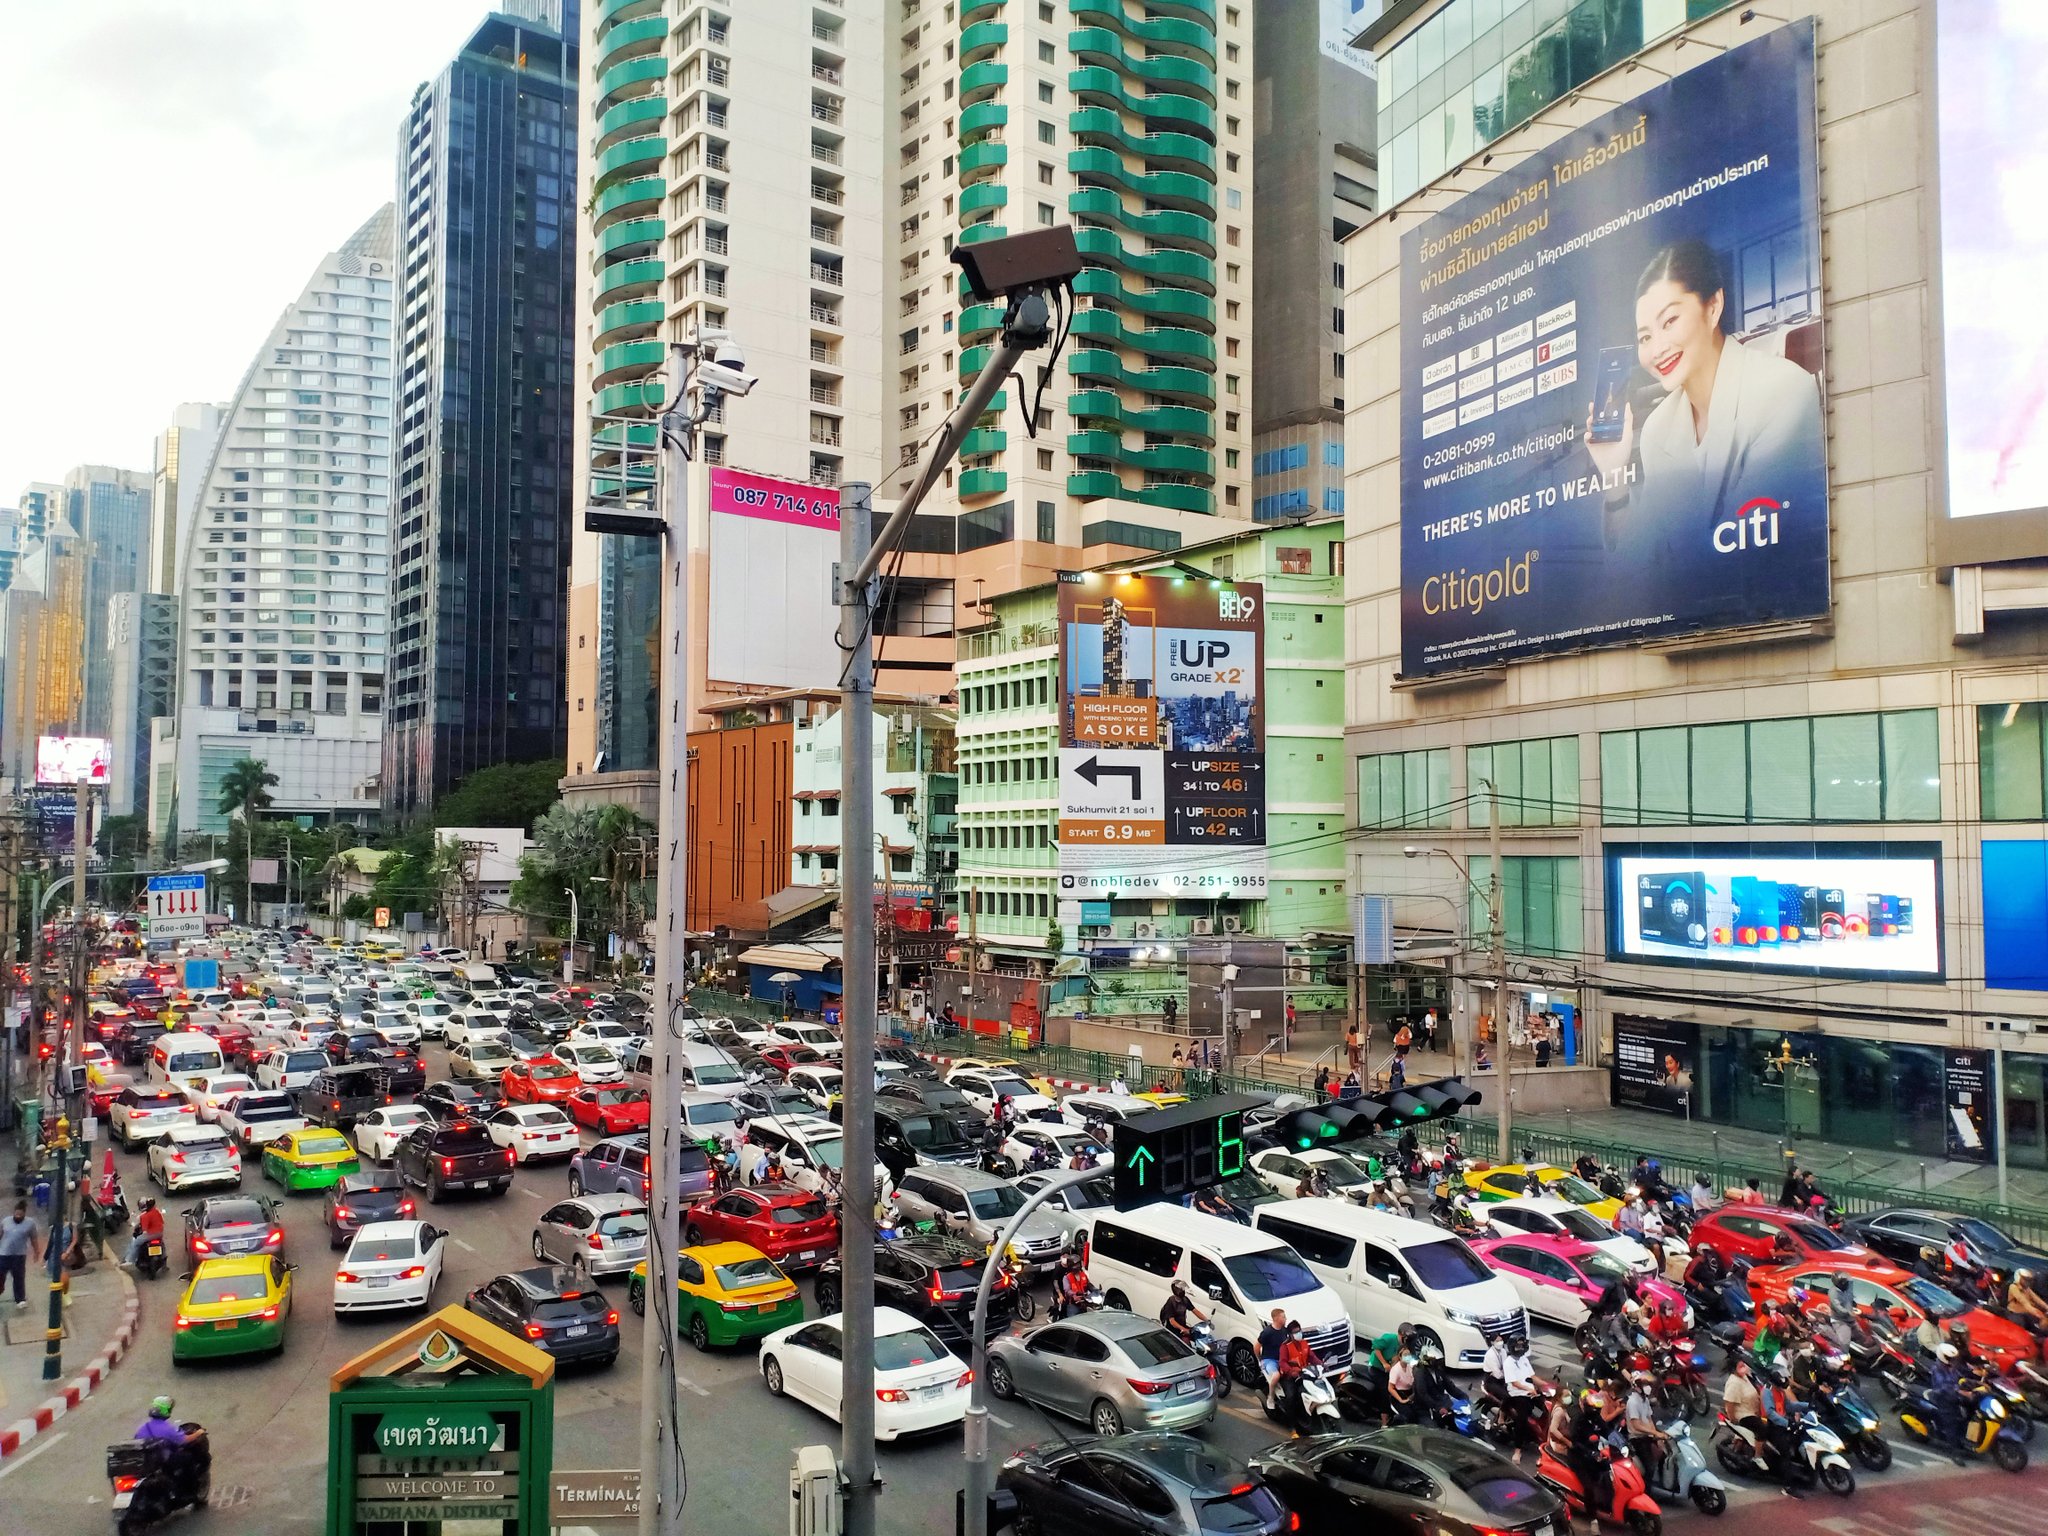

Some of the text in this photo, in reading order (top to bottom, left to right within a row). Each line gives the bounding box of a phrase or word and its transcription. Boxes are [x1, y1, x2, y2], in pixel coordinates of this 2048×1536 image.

[1420, 115, 1647, 264] ซื้อขายกองทุนง่ายๆ ได้แล้ววันนี้
[1420, 210, 1549, 294] ผ่านซิตี้โมบายล์แอป
[1496, 295, 1509, 314] 12
[1513, 286, 1536, 305] บลจ.
[1538, 310, 1573, 330] BlackRock
[1551, 338, 1575, 354] Fidelity
[1553, 365, 1575, 384] UBS
[1499, 385, 1532, 405] Schroders
[1423, 432, 1496, 469] 0-2081-0999
[1423, 425, 1574, 490] www.citibank.co.th/citigold
[734, 487, 768, 506] 087
[773, 493, 807, 514] 714
[1422, 462, 1637, 543] THERE'S MORE TO WEALTH
[1554, 627, 1583, 640] registered
[1583, 624, 1605, 635] service
[1605, 620, 1622, 631] mark
[1622, 619, 1630, 628] of
[1630, 615, 1662, 628] Citigroup
[1662, 613, 1676, 622] Inc.
[1180, 639, 1231, 669] UP
[1170, 672, 1212, 683] GRADE
[1083, 703, 1148, 714] HIGH FLOOR
[1084, 724, 1148, 737] ASOKE
[1191, 761, 1240, 773] UPSIZE
[1183, 781, 1197, 791] 34
[1204, 782, 1220, 791] TO
[1221, 778, 1243, 791] 46
[1067, 805, 1155, 814] Sukhumvit 21 soi 1
[1186, 807, 1247, 818] UPFLOOR
[1068, 829, 1100, 837] START
[1103, 825, 1133, 840] 6.9
[1189, 826, 1204, 836] TO
[1206, 823, 1226, 836] 42
[1078, 875, 1266, 887] @nobledev 02-251-9955
[1825, 889, 1842, 903] citi
[1955, 1057, 1971, 1066] citi
[1219, 1111, 1243, 1177] 6
[383, 1417, 488, 1447] เขตวัฒนา
[386, 1480, 495, 1494] WELCOME TO
[360, 1503, 515, 1520] VADHANA DISTRICT
[624, 1503, 640, 1512] AS
